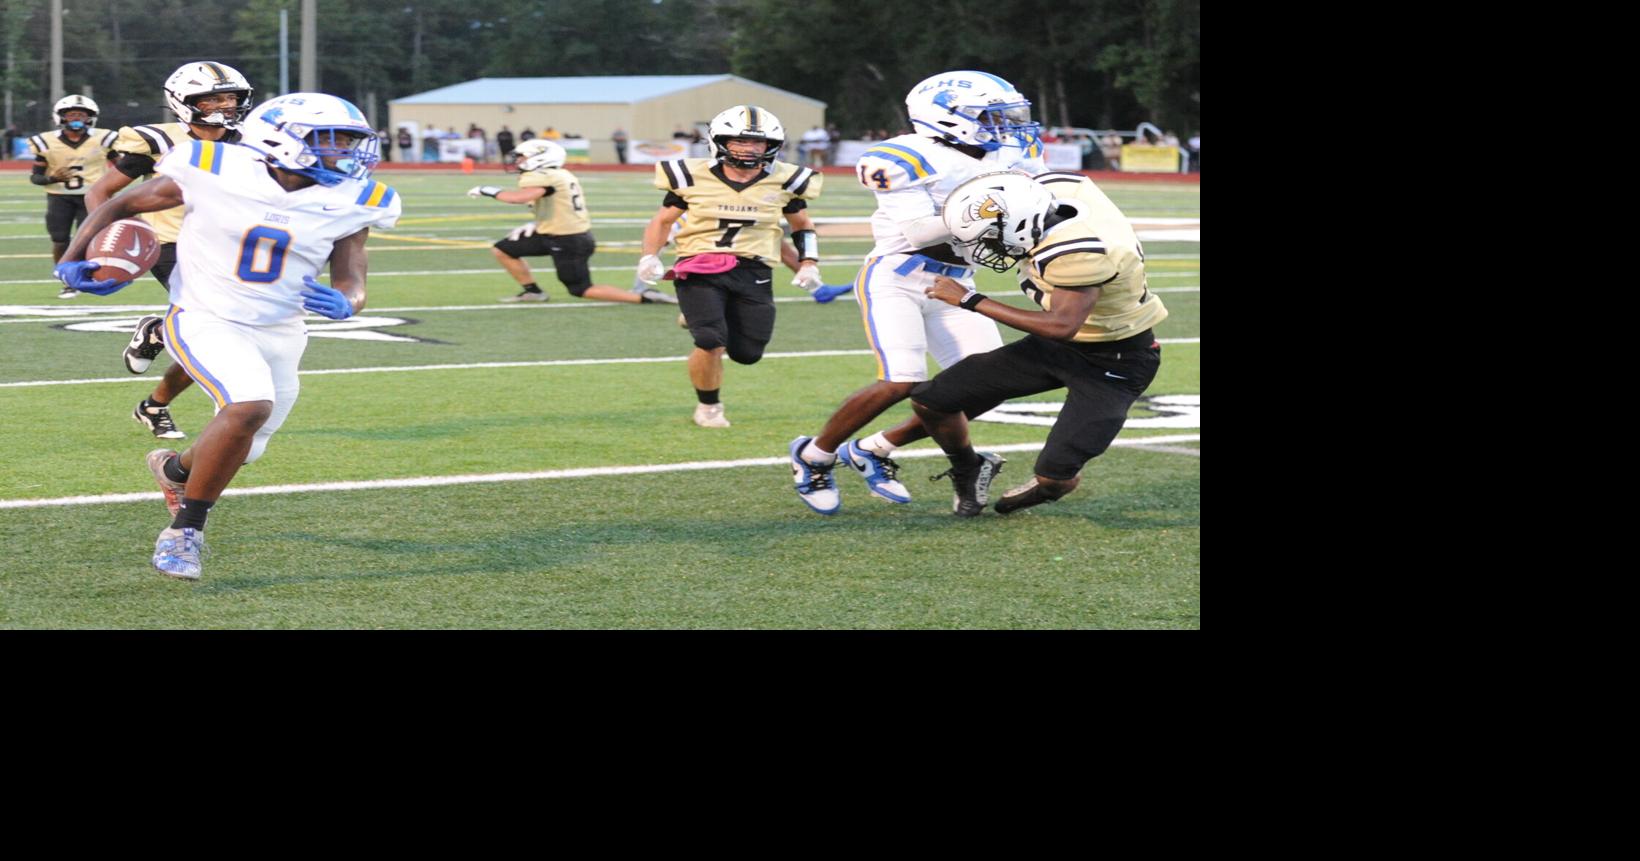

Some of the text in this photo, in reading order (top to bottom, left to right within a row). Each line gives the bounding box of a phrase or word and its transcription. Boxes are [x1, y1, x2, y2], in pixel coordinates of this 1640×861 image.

[918, 79, 972, 94] LHS
[860, 164, 889, 190] 14
[718, 204, 759, 213] TROJANS
[714, 217, 757, 248] 7
[235, 224, 293, 284] 0
